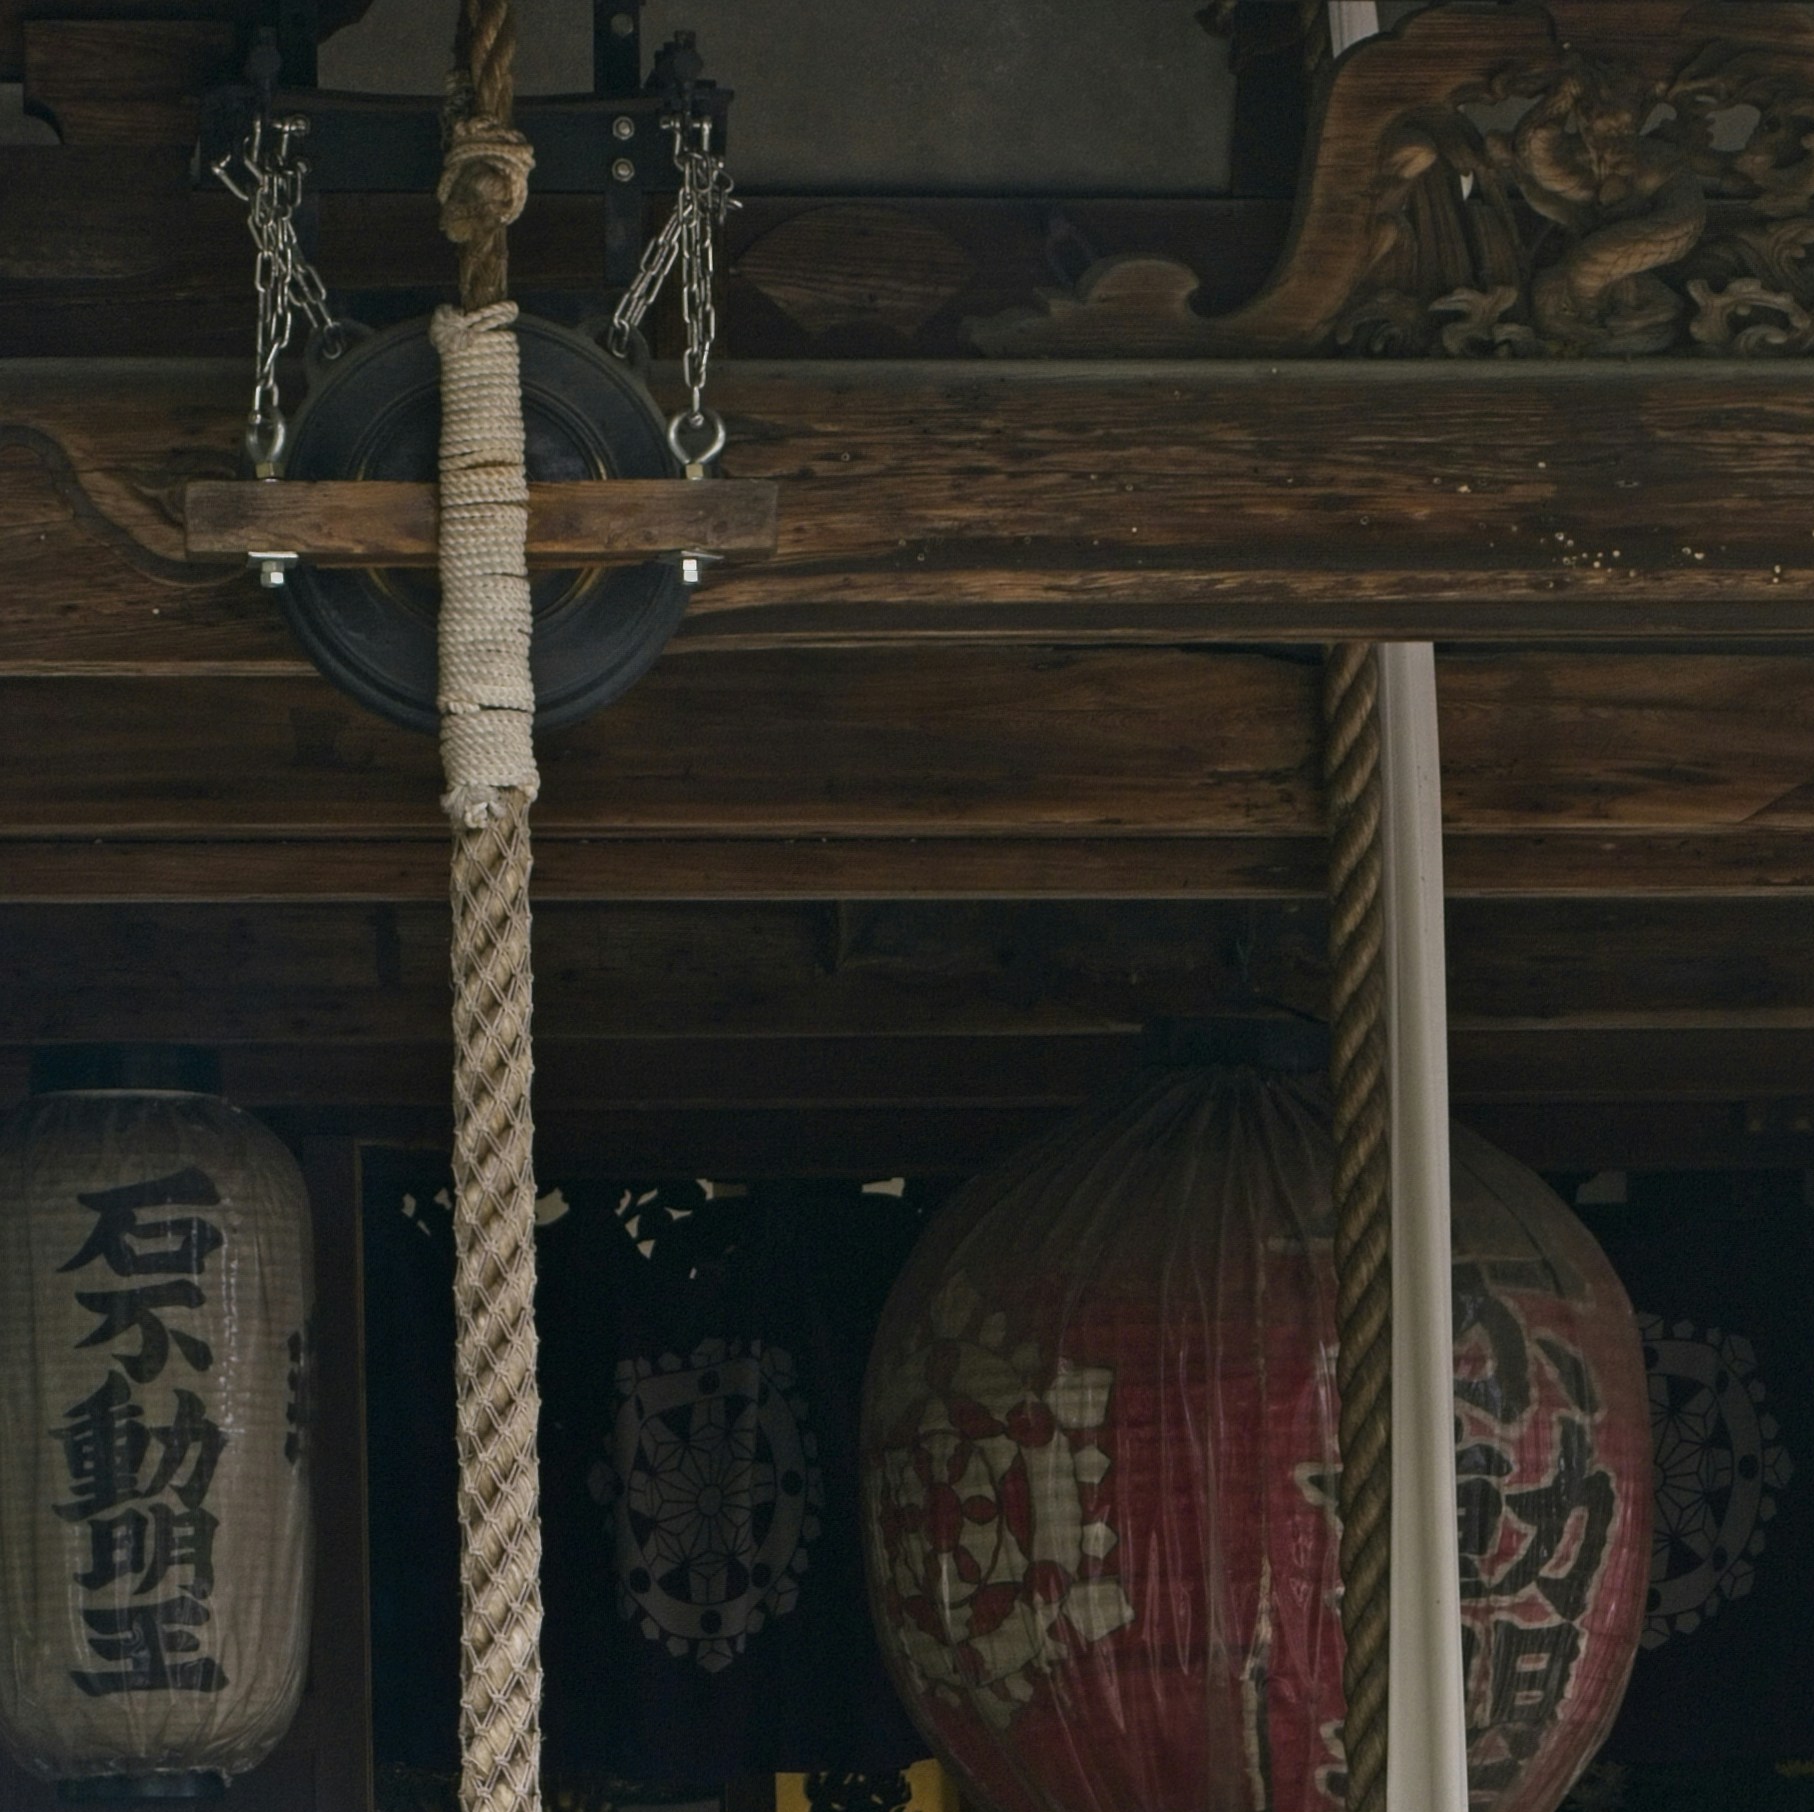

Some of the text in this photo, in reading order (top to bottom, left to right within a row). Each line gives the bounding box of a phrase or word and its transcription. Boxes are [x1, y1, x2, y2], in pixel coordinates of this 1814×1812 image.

[50, 1166, 231, 1696] 石不動明王
